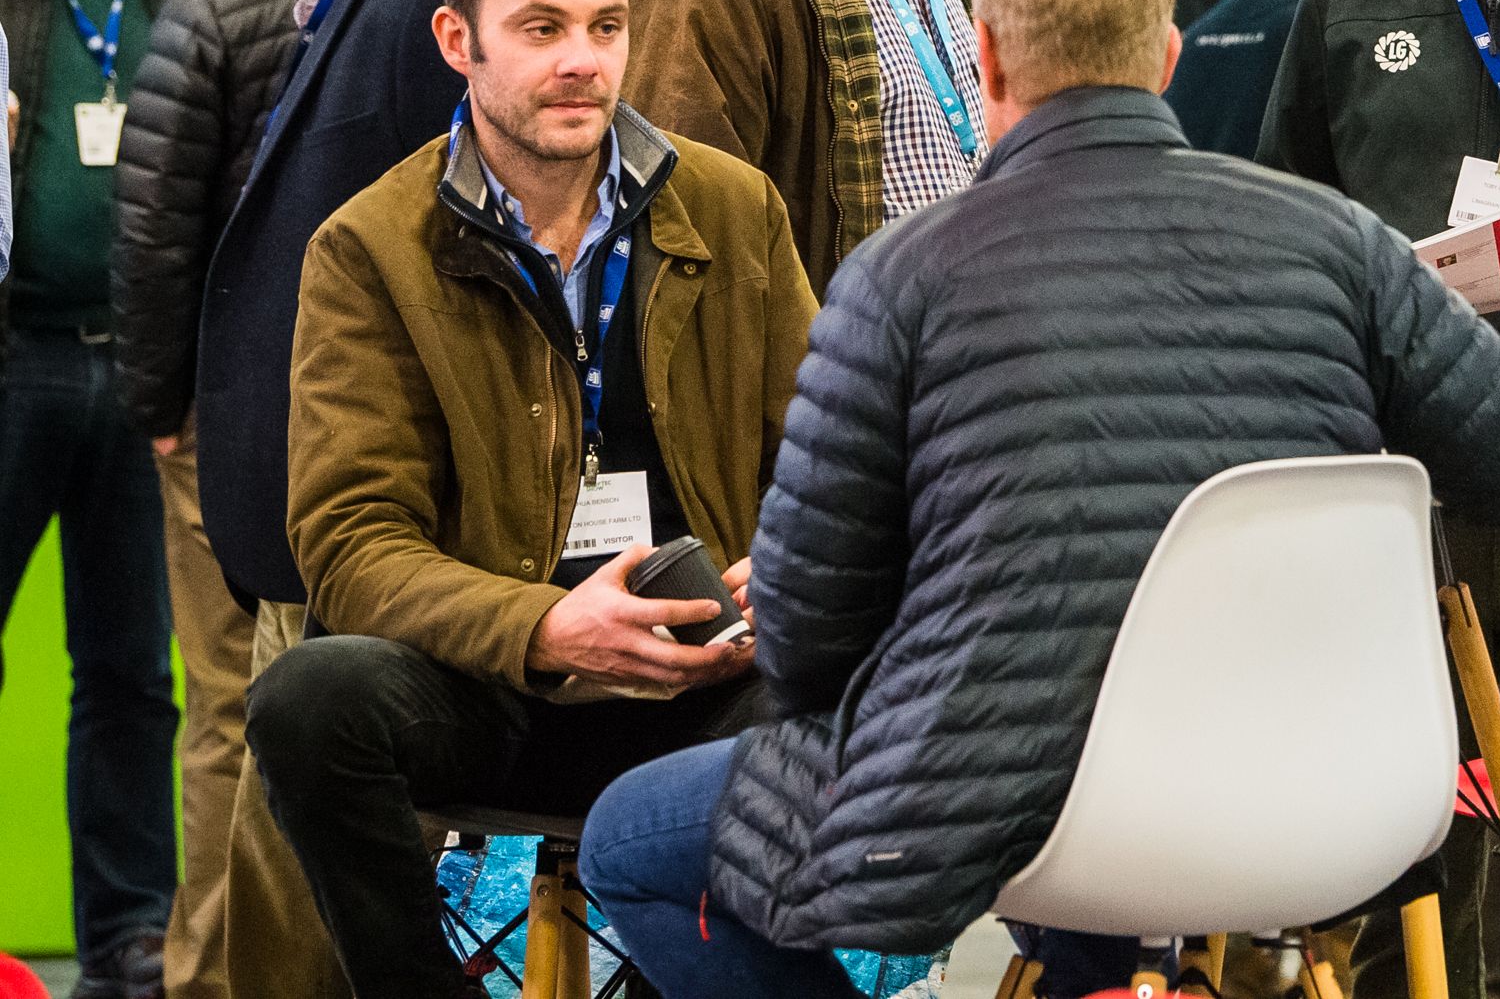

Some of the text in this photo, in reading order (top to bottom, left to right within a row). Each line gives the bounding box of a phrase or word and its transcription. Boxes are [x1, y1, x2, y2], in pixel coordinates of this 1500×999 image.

[1389, 41, 1407, 59] LG
[592, 497, 619, 505] BENSON
[584, 519, 606, 527] HOUSE
[608, 516, 627, 524] FARM
[603, 535, 634, 544] VISITOR
